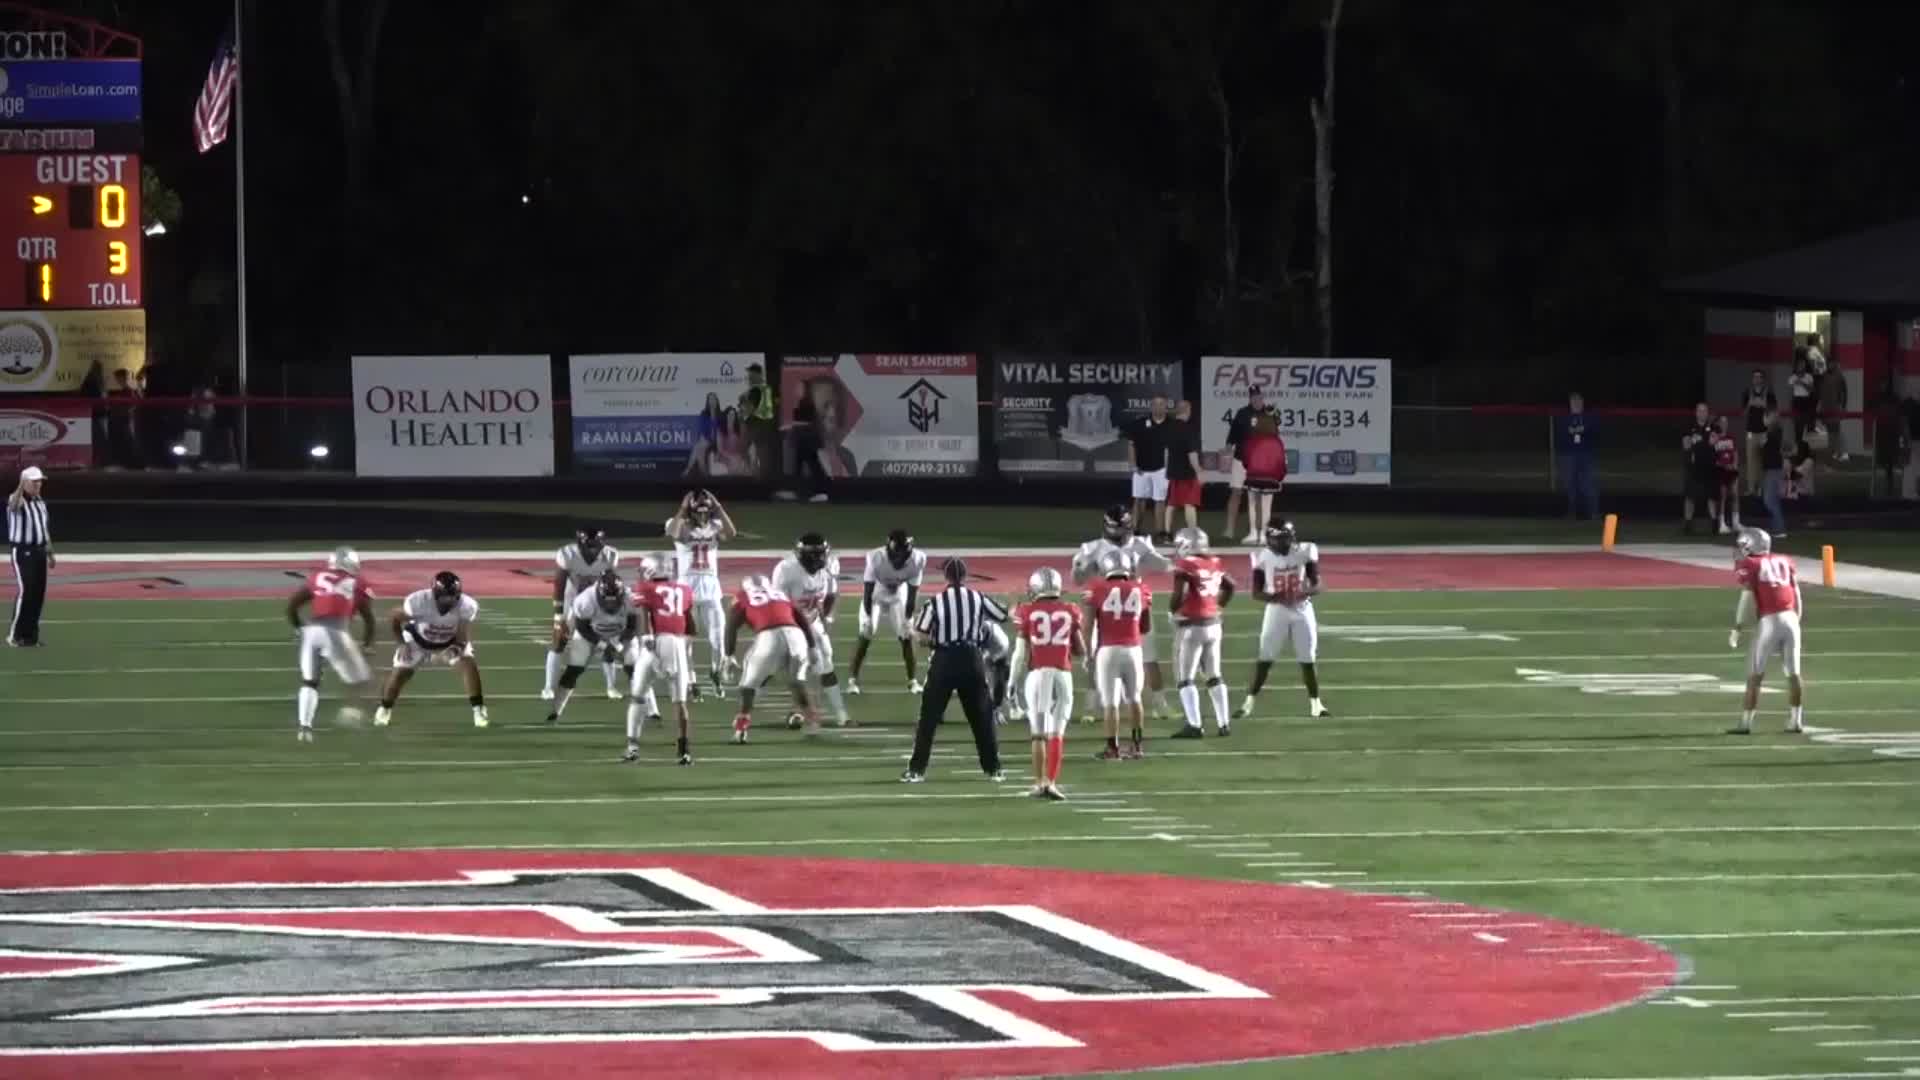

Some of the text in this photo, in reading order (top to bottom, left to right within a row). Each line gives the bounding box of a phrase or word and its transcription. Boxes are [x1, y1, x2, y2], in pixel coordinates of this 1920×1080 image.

[37, 155, 127, 183] GUEST
[100, 184, 125, 228] 0
[17, 237, 56, 260] QTR
[109, 241, 128, 274] 3
[41, 263, 50, 302] 1
[88, 283, 137, 305] T.O.L.
[875, 355, 968, 367] SEAN SANDERS
[1001, 362, 1174, 384] VITAL SECURITY
[1002, 397, 1052, 408] SECURITY
[691, 544, 717, 570] 11
[1759, 556, 1791, 586] 40
[313, 573, 355, 600] 54
[656, 585, 685, 616] 31
[1102, 594, 1142, 620] 44
[1030, 610, 1072, 646] 32
